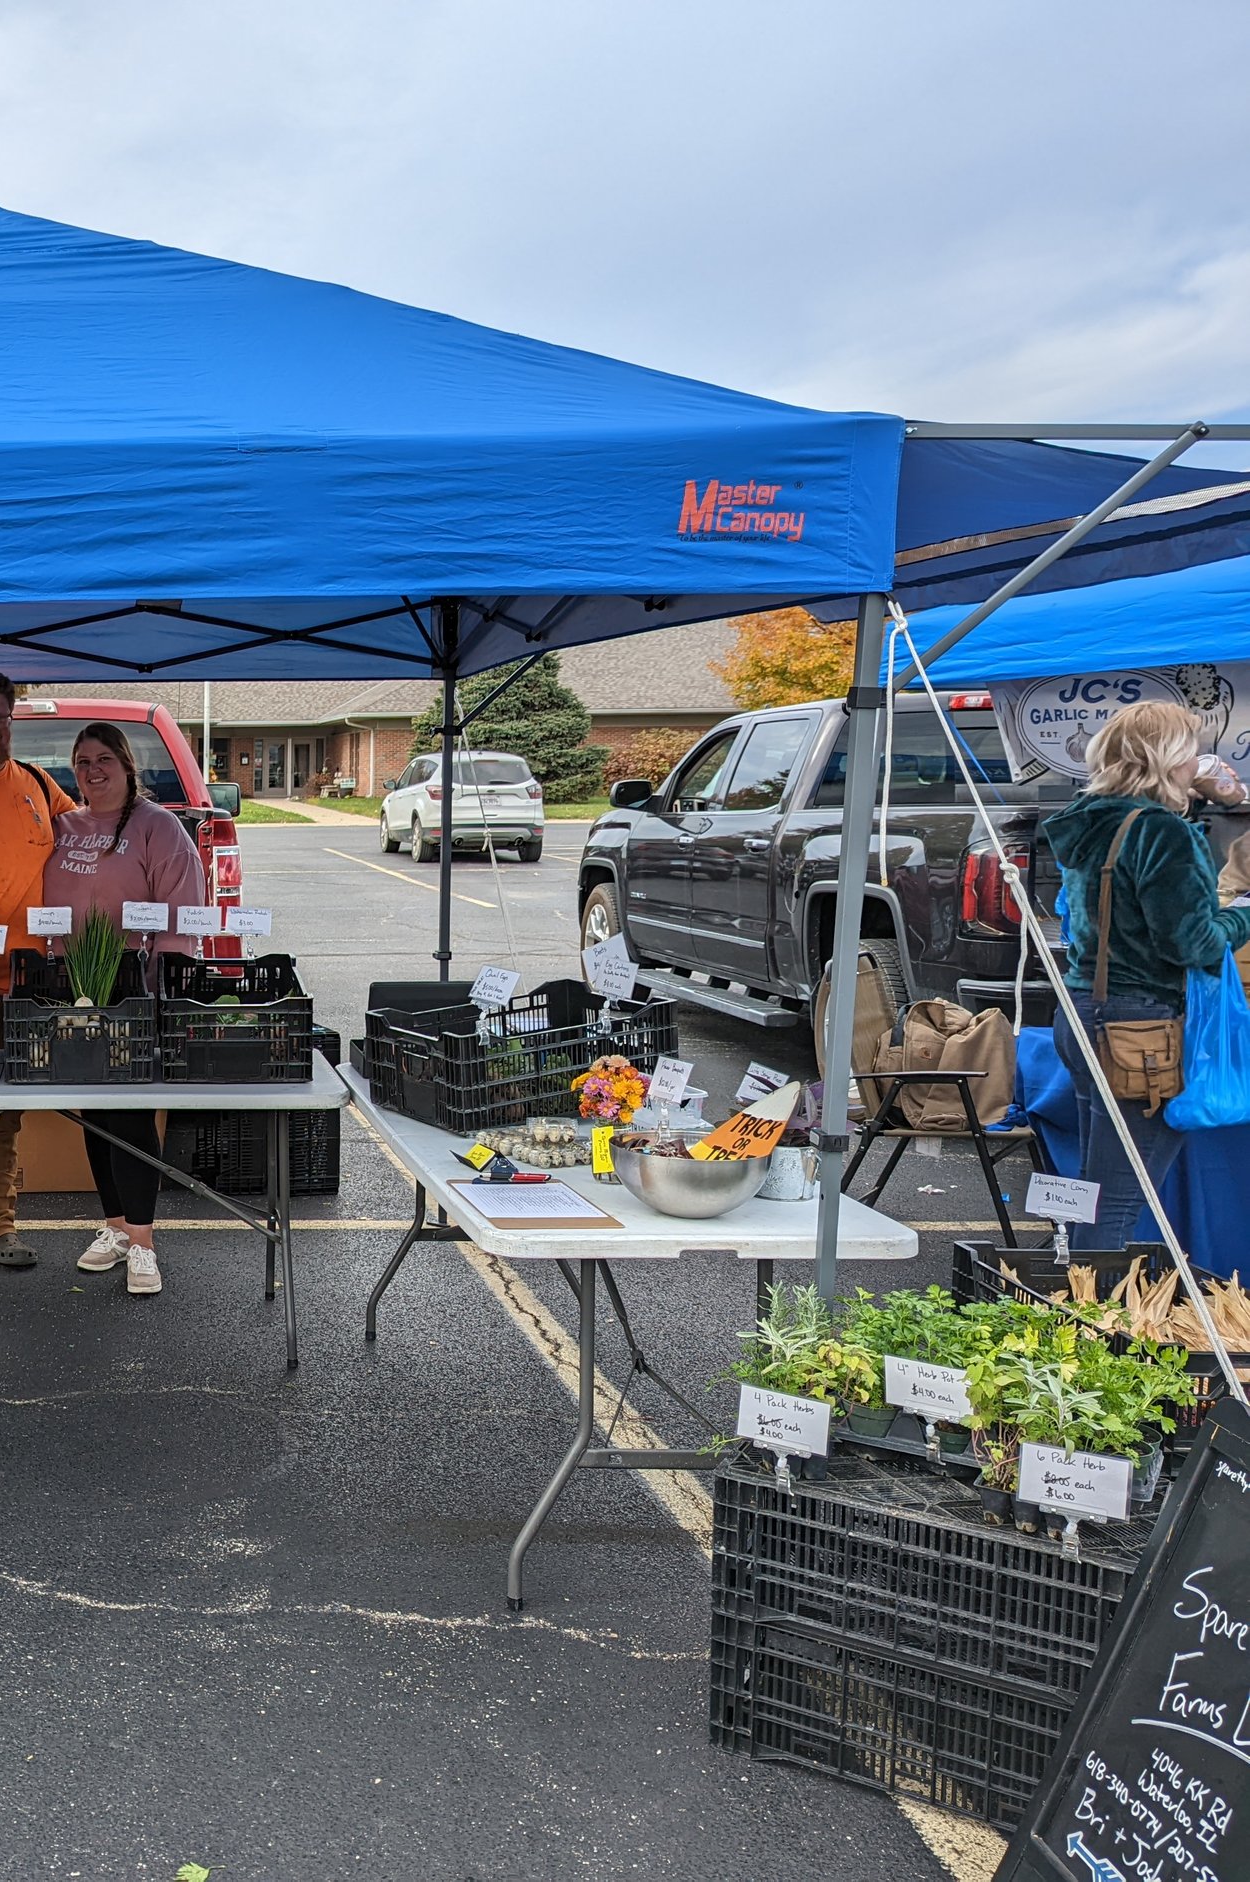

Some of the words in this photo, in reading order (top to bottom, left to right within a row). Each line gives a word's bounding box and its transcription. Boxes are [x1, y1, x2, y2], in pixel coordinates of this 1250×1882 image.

[678, 480, 782, 533] Master
[715, 507, 805, 542] Canopy
[1059, 678, 1144, 704] JC'S
[1030, 708, 1089, 725] GARLIC
[1040, 731, 1062, 739] EST.
[78, 833, 129, 855] HARBR
[60, 860, 98, 875] MAINE
[593, 946, 607, 957] Beets
[485, 968, 500, 978] Quail
[730, 1112, 783, 1140] TRICK
[732, 1137, 751, 1150] OR
[1034, 1175, 1066, 1189] Decorative
[1070, 1181, 1089, 1194] Corn
[1044, 1191, 1063, 1204] $1.00
[1064, 1198, 1078, 1207] each
[917, 1366, 937, 1380] Herb
[941, 1371, 954, 1384] Pot
[911, 1383, 936, 1399] $4.00
[937, 1394, 955, 1404] each
[754, 1392, 761, 1403] 4
[766, 1394, 788, 1410] Pack
[793, 1401, 815, 1416] Herbs
[759, 1427, 784, 1440] $4.00
[784, 1423, 802, 1434] each
[1036, 1450, 1045, 1461] 6
[1051, 1451, 1076, 1466] Pack
[1083, 1457, 1106, 1472] Herb
[1045, 1486, 1075, 1501] $6.00
[1074, 1480, 1095, 1492] each
[1173, 1566, 1248, 1651] Spare
[1158, 1651, 1227, 1729] Farms
[1151, 1748, 1183, 1789] 4046
[1185, 1777, 1211, 1810] KK
[1207, 1797, 1233, 1836] Rd
[1075, 1787, 1110, 1835] Bri
[1138, 1769, 1193, 1835] Waterloo,
[1196, 1819, 1219, 1855] IL
